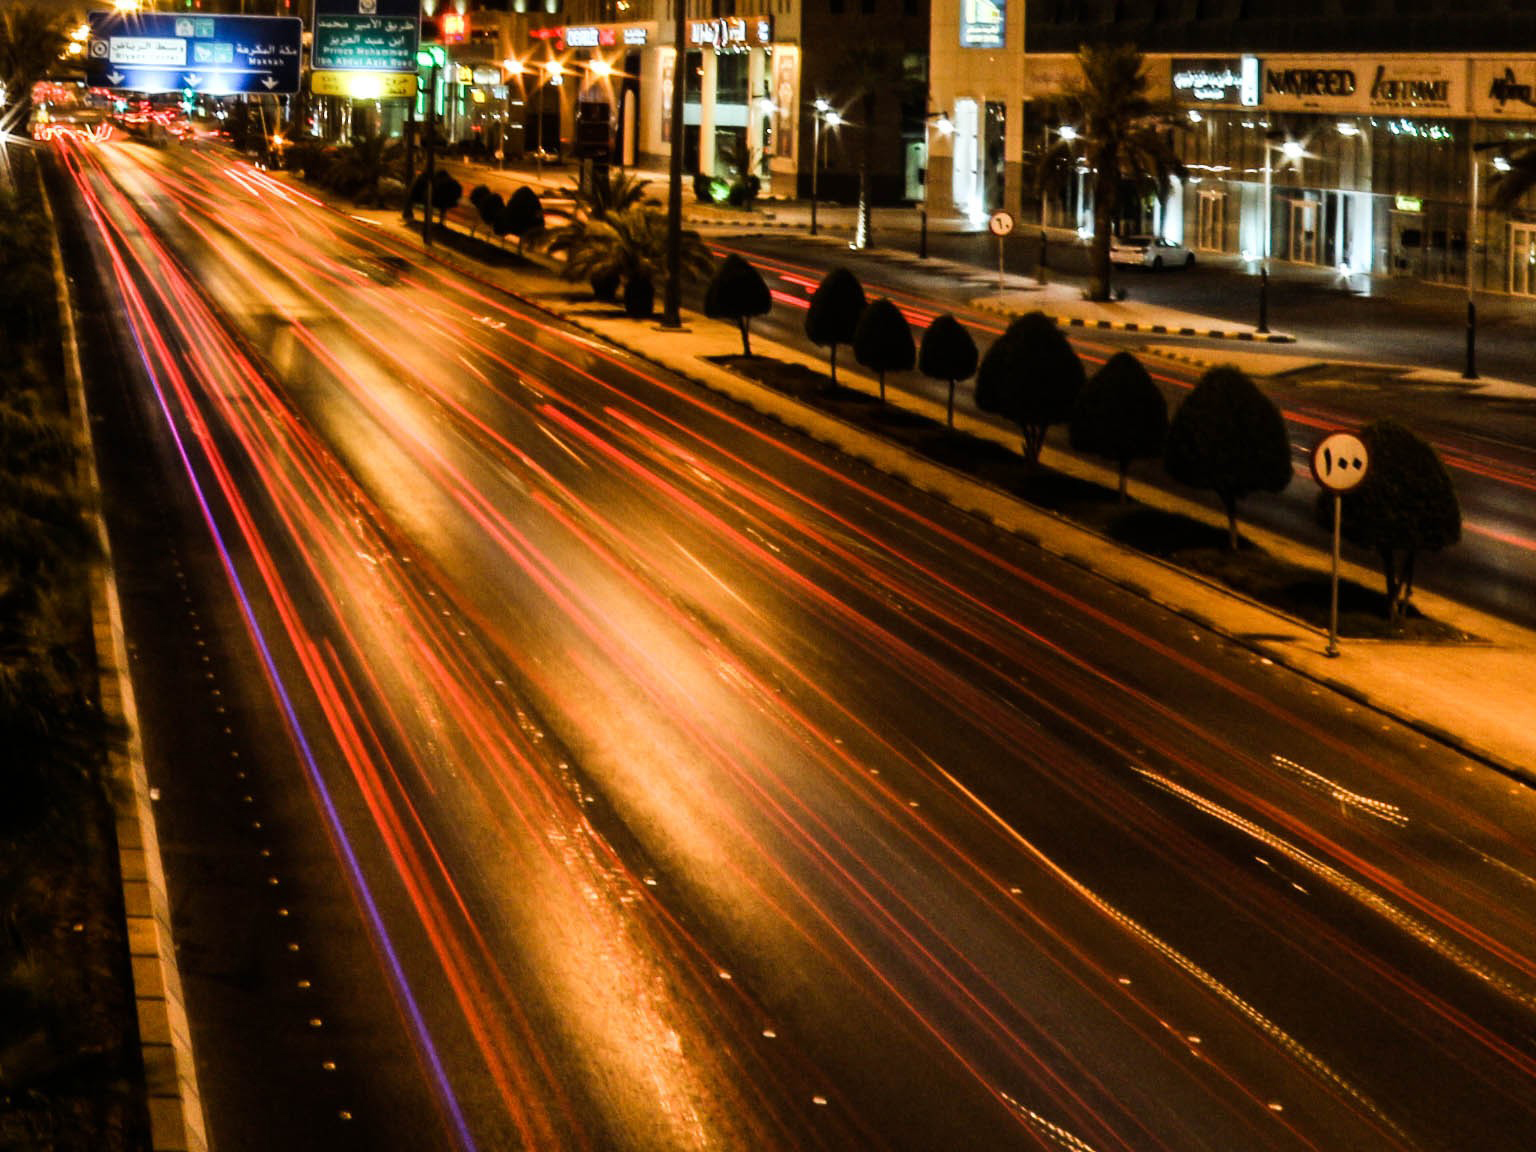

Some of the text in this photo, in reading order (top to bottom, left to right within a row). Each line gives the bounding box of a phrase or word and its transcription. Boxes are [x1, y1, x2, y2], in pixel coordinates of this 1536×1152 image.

[384, 20, 414, 32] طريق
[323, 46, 354, 56] Prince
[1324, 448, 1362, 476] ١٠٠
